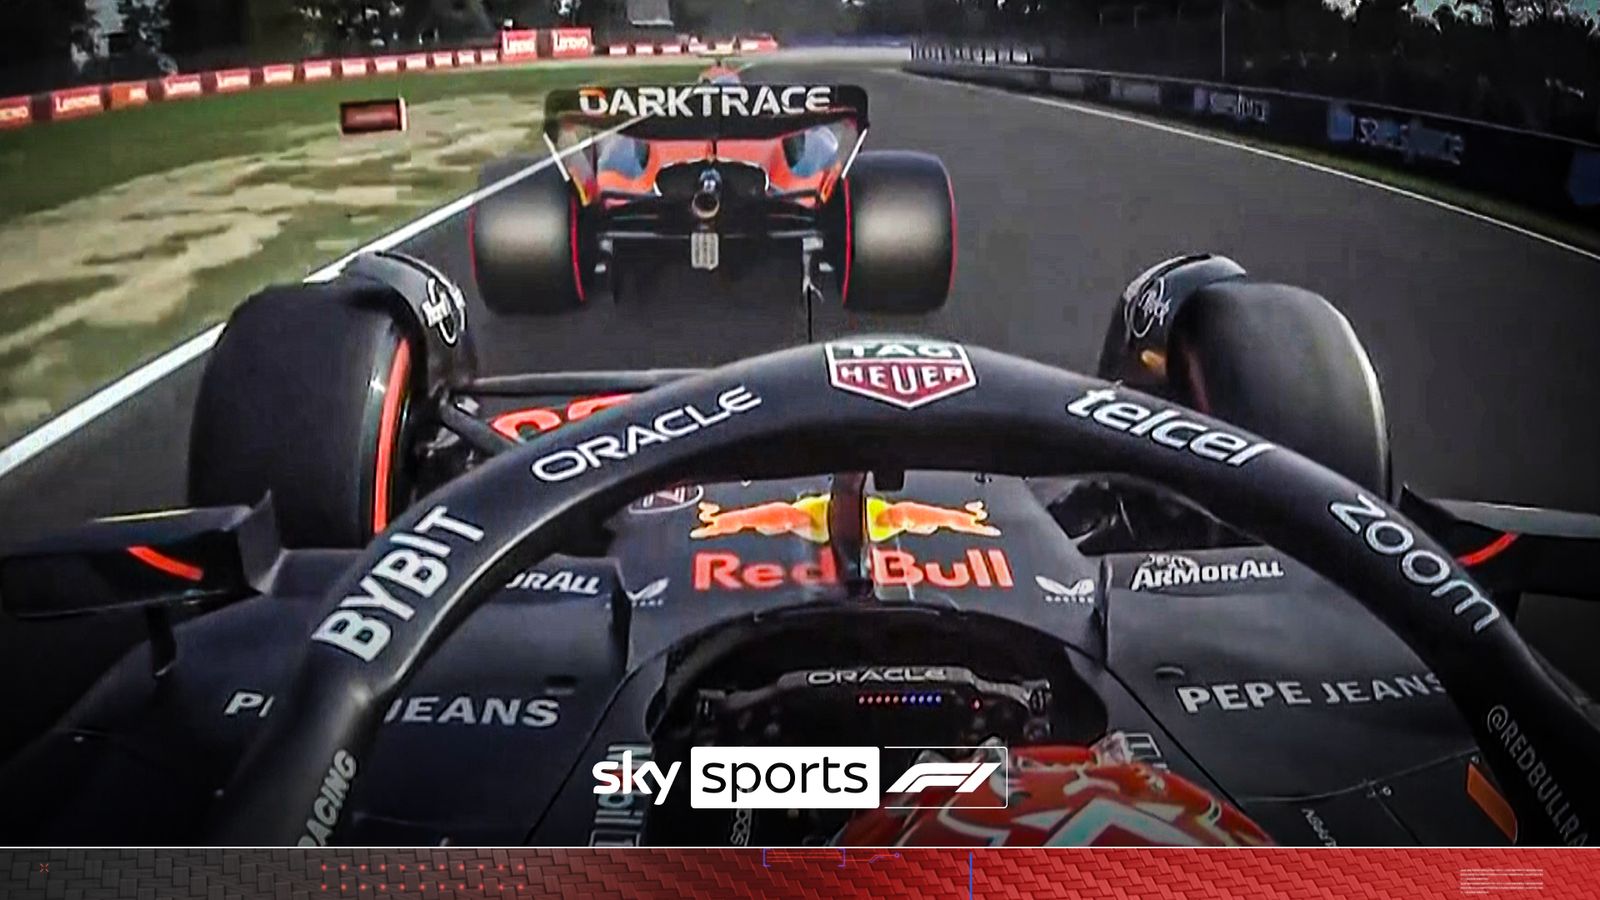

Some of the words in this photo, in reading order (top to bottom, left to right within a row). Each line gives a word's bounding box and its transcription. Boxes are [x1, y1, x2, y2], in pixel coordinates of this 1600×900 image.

[578, 86, 832, 117] DARKTRACE
[840, 363, 963, 395] HEUER
[531, 386, 763, 482] ORACLE
[1065, 388, 1277, 467] telcel
[312, 505, 486, 663] BYBIT
[692, 551, 837, 590] Red
[871, 549, 1014, 589] Bull
[1329, 494, 1501, 634] zoom
[808, 668, 946, 685] ORACLE
[1178, 682, 1312, 714] PEPE
